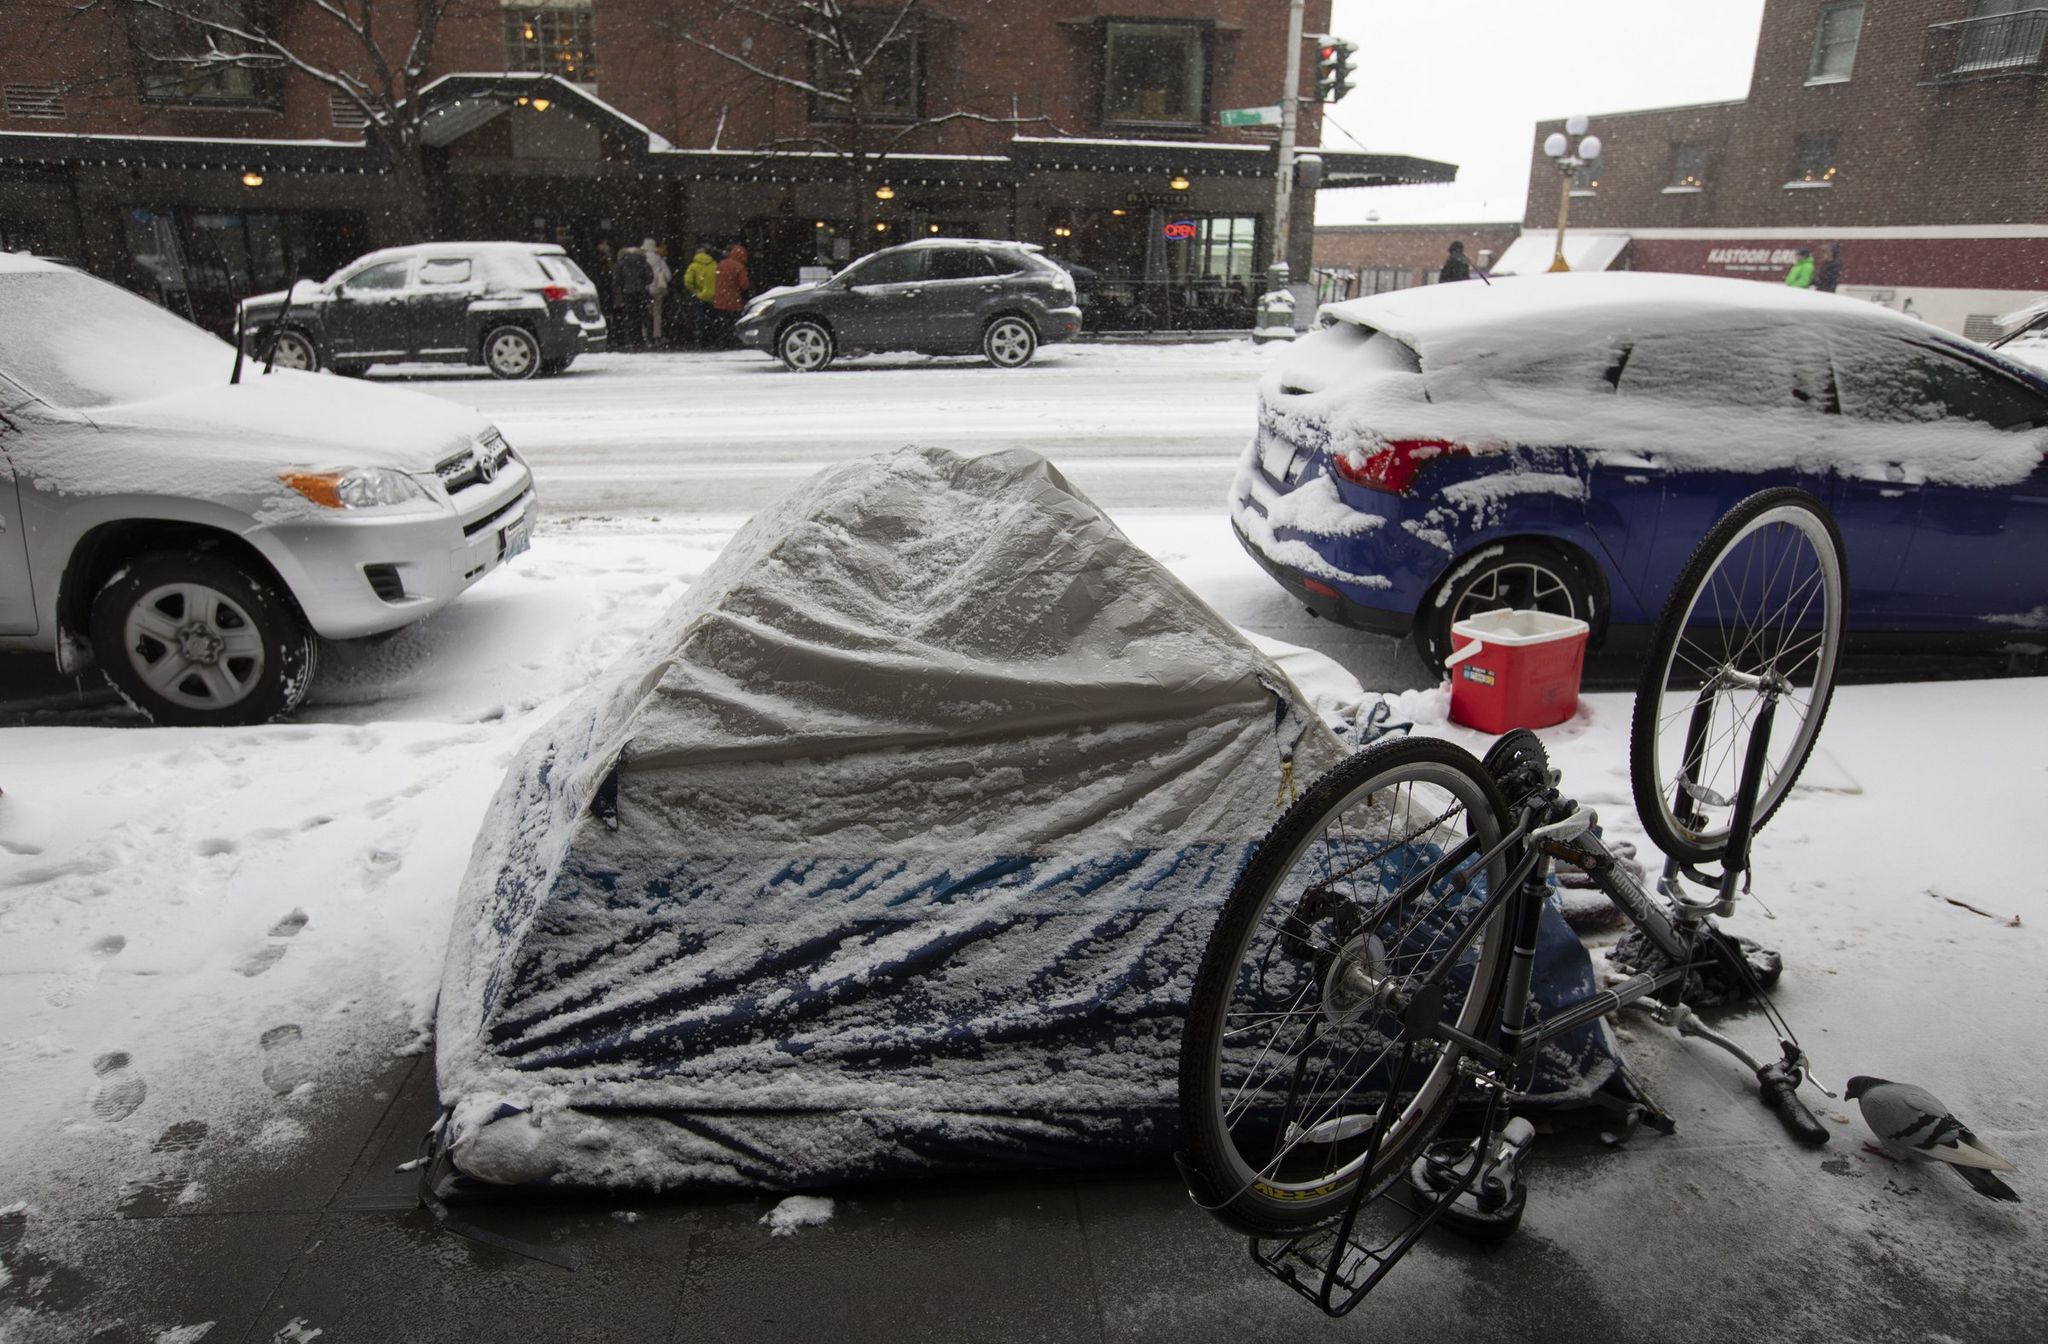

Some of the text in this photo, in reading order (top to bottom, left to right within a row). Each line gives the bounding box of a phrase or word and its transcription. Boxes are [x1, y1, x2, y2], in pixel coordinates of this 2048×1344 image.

[1164, 223, 1196, 238] OPEN
[1707, 249, 1770, 263] KASTOORI
[1608, 864, 1655, 921] Schwinn
